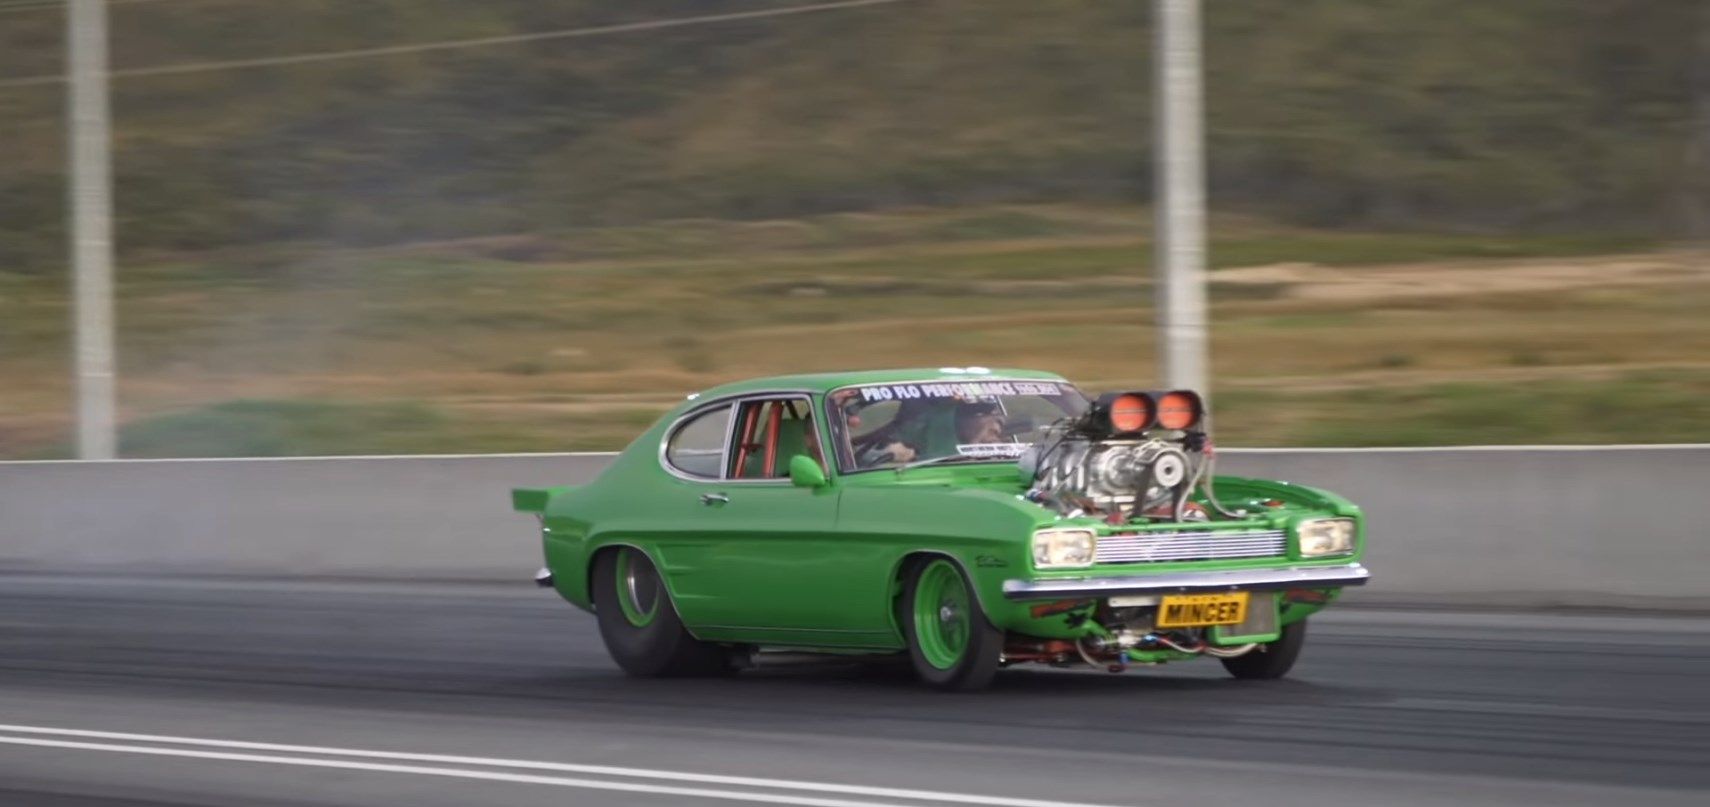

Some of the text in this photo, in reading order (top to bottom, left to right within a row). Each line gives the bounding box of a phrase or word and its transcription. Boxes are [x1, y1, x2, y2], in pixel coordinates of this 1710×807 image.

[861, 387, 892, 401] PRO
[893, 385, 920, 399] FLO
[921, 382, 1016, 398] PERFORMANCE
